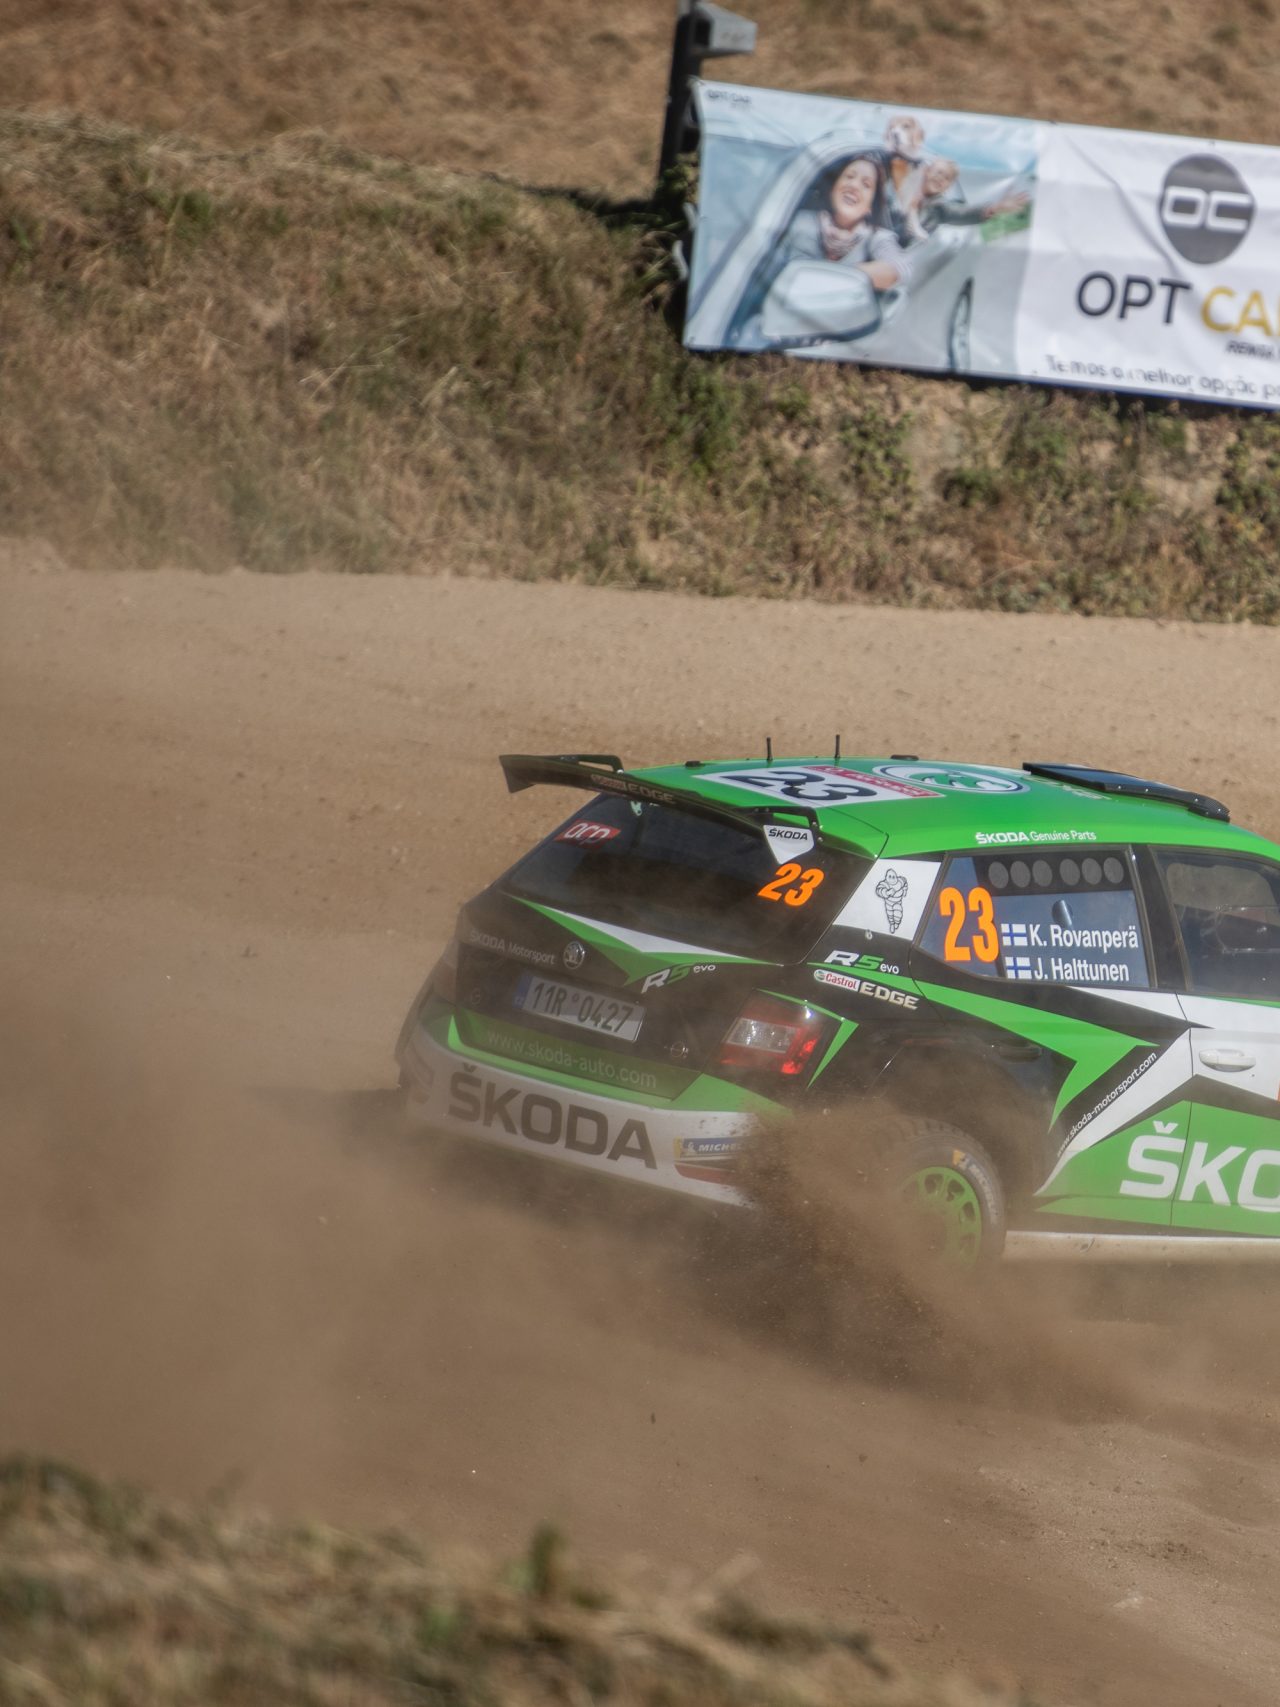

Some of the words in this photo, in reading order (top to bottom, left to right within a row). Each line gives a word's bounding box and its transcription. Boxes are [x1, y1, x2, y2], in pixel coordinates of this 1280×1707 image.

[1075, 270, 1193, 326] OPT
[768, 828, 809, 841] ŠKODA
[975, 831, 1030, 844] ŠKODA
[1029, 831, 1070, 842] Genuine
[1070, 830, 1097, 841] Parts
[757, 863, 825, 906] 23
[938, 886, 1000, 962] 23
[1029, 924, 1048, 947] K.
[1050, 924, 1139, 954] Rovanperä
[1034, 957, 1048, 980] J.
[1051, 957, 1130, 982] Halttunen
[532, 982, 568, 1017] 11R
[577, 995, 634, 1033] 0427
[825, 972, 857, 990] Castrol
[859, 981, 920, 1011] EDGE
[487, 1031, 657, 1089] www.skoda-auto.com
[448, 1062, 659, 1171] ŠKODA
